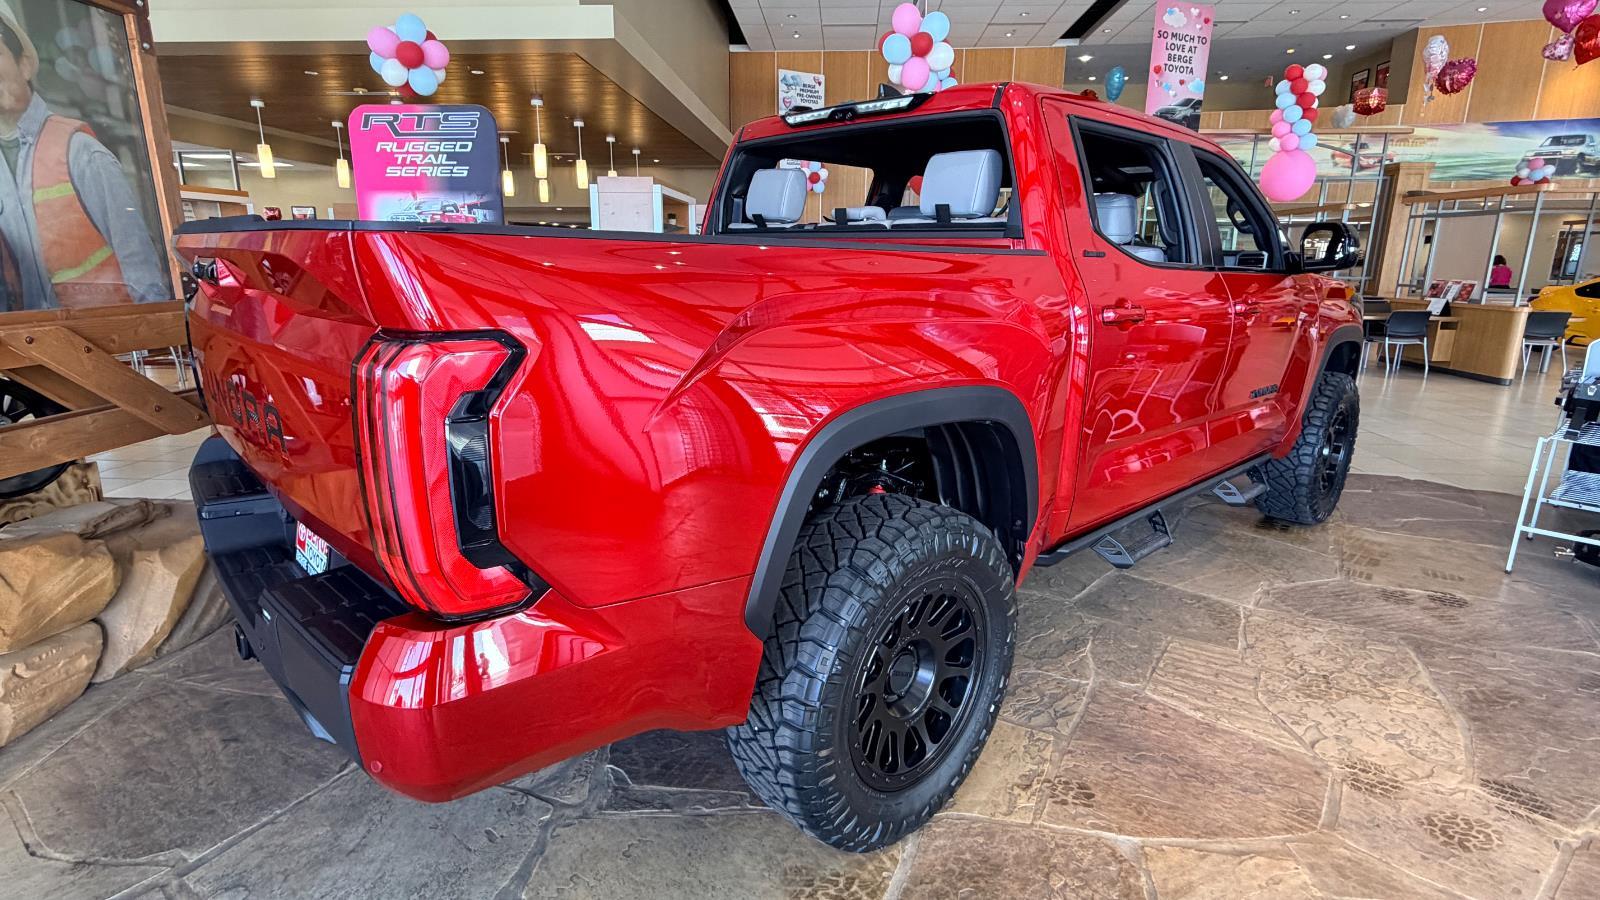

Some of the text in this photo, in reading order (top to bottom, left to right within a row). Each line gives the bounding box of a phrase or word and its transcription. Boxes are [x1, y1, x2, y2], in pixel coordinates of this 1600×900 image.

[1157, 30, 1207, 45] SO MUCH TO
[1165, 42, 1197, 54] LOVE AT
[1167, 53, 1192, 64] BERGE
[1164, 63, 1194, 75] TOYOTA
[361, 112, 480, 138] RTS
[375, 141, 473, 152] RUGGED
[393, 154, 458, 165] TRAIL
[384, 166, 470, 177] SERIES
